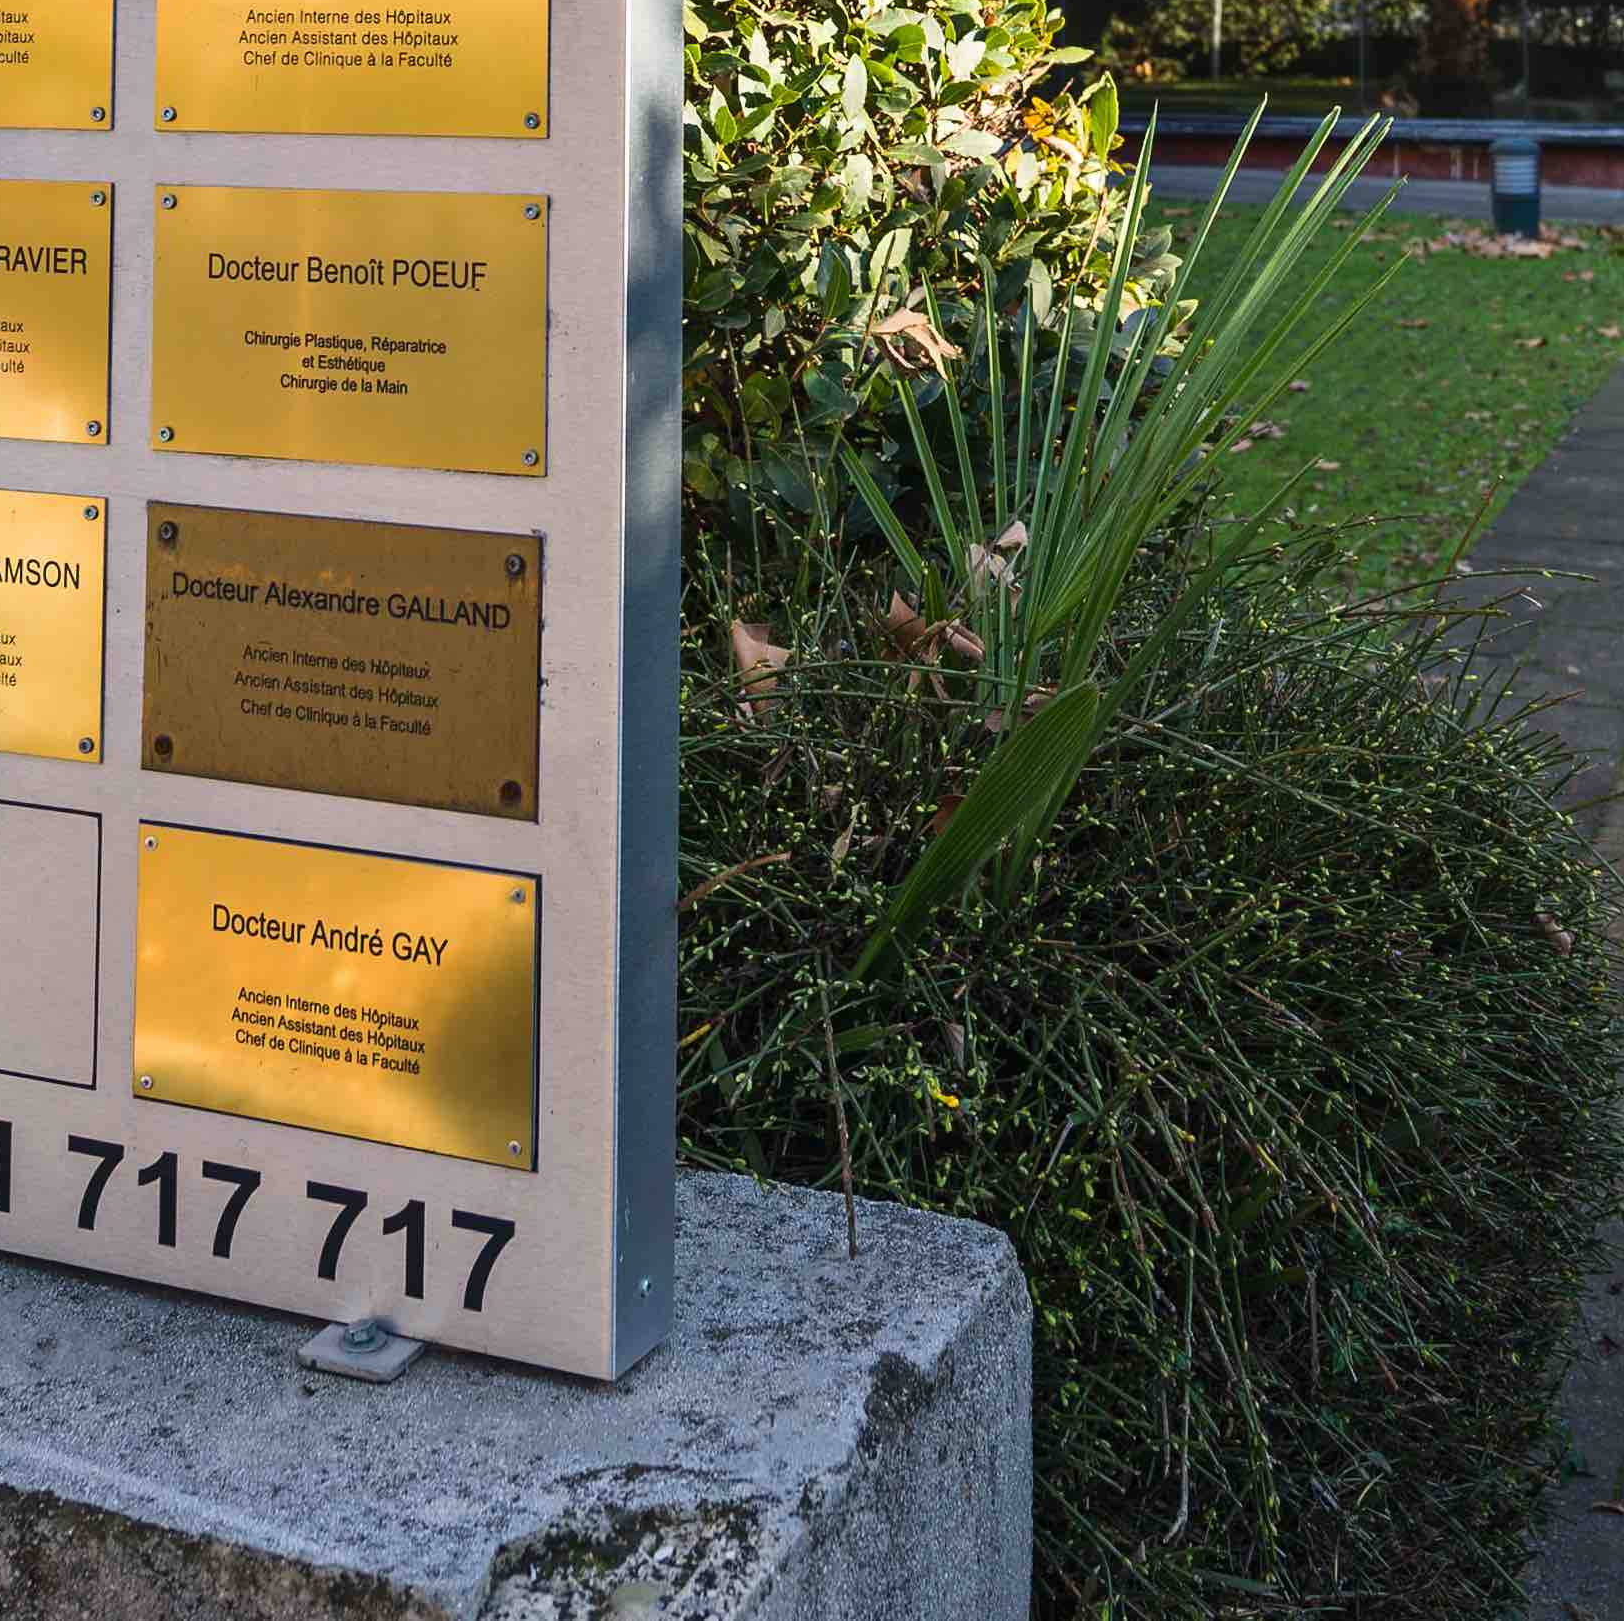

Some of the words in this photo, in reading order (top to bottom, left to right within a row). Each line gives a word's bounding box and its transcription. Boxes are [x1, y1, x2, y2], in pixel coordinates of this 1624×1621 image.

[246, 10, 295, 24] Ancien
[300, 10, 349, 24] Interne
[355, 10, 380, 24] des
[386, 8, 451, 28] Hôpitaux
[239, 31, 286, 45] Ancien
[291, 31, 357, 46] Assistant
[362, 31, 388, 46] des
[393, 30, 458, 49] Hôpitaux
[243, 51, 276, 66] Chef
[281, 51, 299, 66] de
[303, 51, 362, 70] Clinique
[367, 52, 376, 67] à
[380, 53, 393, 67] la
[399, 51, 452, 68] Faculté
[208, 253, 299, 282] Docteur
[307, 256, 384, 286] Benoît
[393, 260, 488, 289] POEUF
[244, 331, 301, 350] Chirurgie
[305, 333, 367, 353] Plastique,
[371, 335, 447, 354] Réparatrice
[302, 355, 314, 369] et
[318, 355, 386, 374] Esthétique
[280, 374, 337, 394] Chirurgie
[341, 377, 357, 392] de
[361, 378, 373, 393] la
[377, 379, 408, 395] Main
[172, 571, 259, 605] Docteur
[264, 582, 380, 616] Alexandre
[387, 592, 510, 630] GALLAND
[242, 645, 288, 664] Ancien
[292, 650, 338, 669] Interne
[342, 655, 366, 674] des
[371, 658, 431, 679] Hôpitaux
[234, 670, 281, 691] Ancien
[283, 676, 346, 698] Assistant
[349, 683, 374, 702] des
[378, 687, 439, 708] Hôpitaux
[240, 699, 272, 716] Chef
[276, 702, 292, 720] de
[295, 704, 348, 728] Clinique
[365, 712, 377, 729] la
[380, 715, 431, 736] Faculté
[213, 904, 305, 944] Docteur
[311, 919, 383, 956] André
[392, 932, 448, 966] GAY
[238, 986, 282, 1007] Ancien
[286, 994, 329, 1015] Interne
[334, 1002, 357, 1020] des
[361, 1006, 419, 1031] Hôpitaux
[232, 1007, 275, 1027] Ancien
[278, 1014, 336, 1038] Assistant
[339, 1025, 363, 1043] des
[367, 1029, 425, 1054] Hôpitaux
[235, 1029, 266, 1046] Chef
[269, 1035, 285, 1050] de
[288, 1039, 340, 1061] Clinique
[344, 1047, 352, 1062] à
[356, 1049, 367, 1065] la
[372, 1052, 420, 1074] Faculté
[67, 1133, 263, 1259] 717
[305, 1179, 517, 1314] 717
